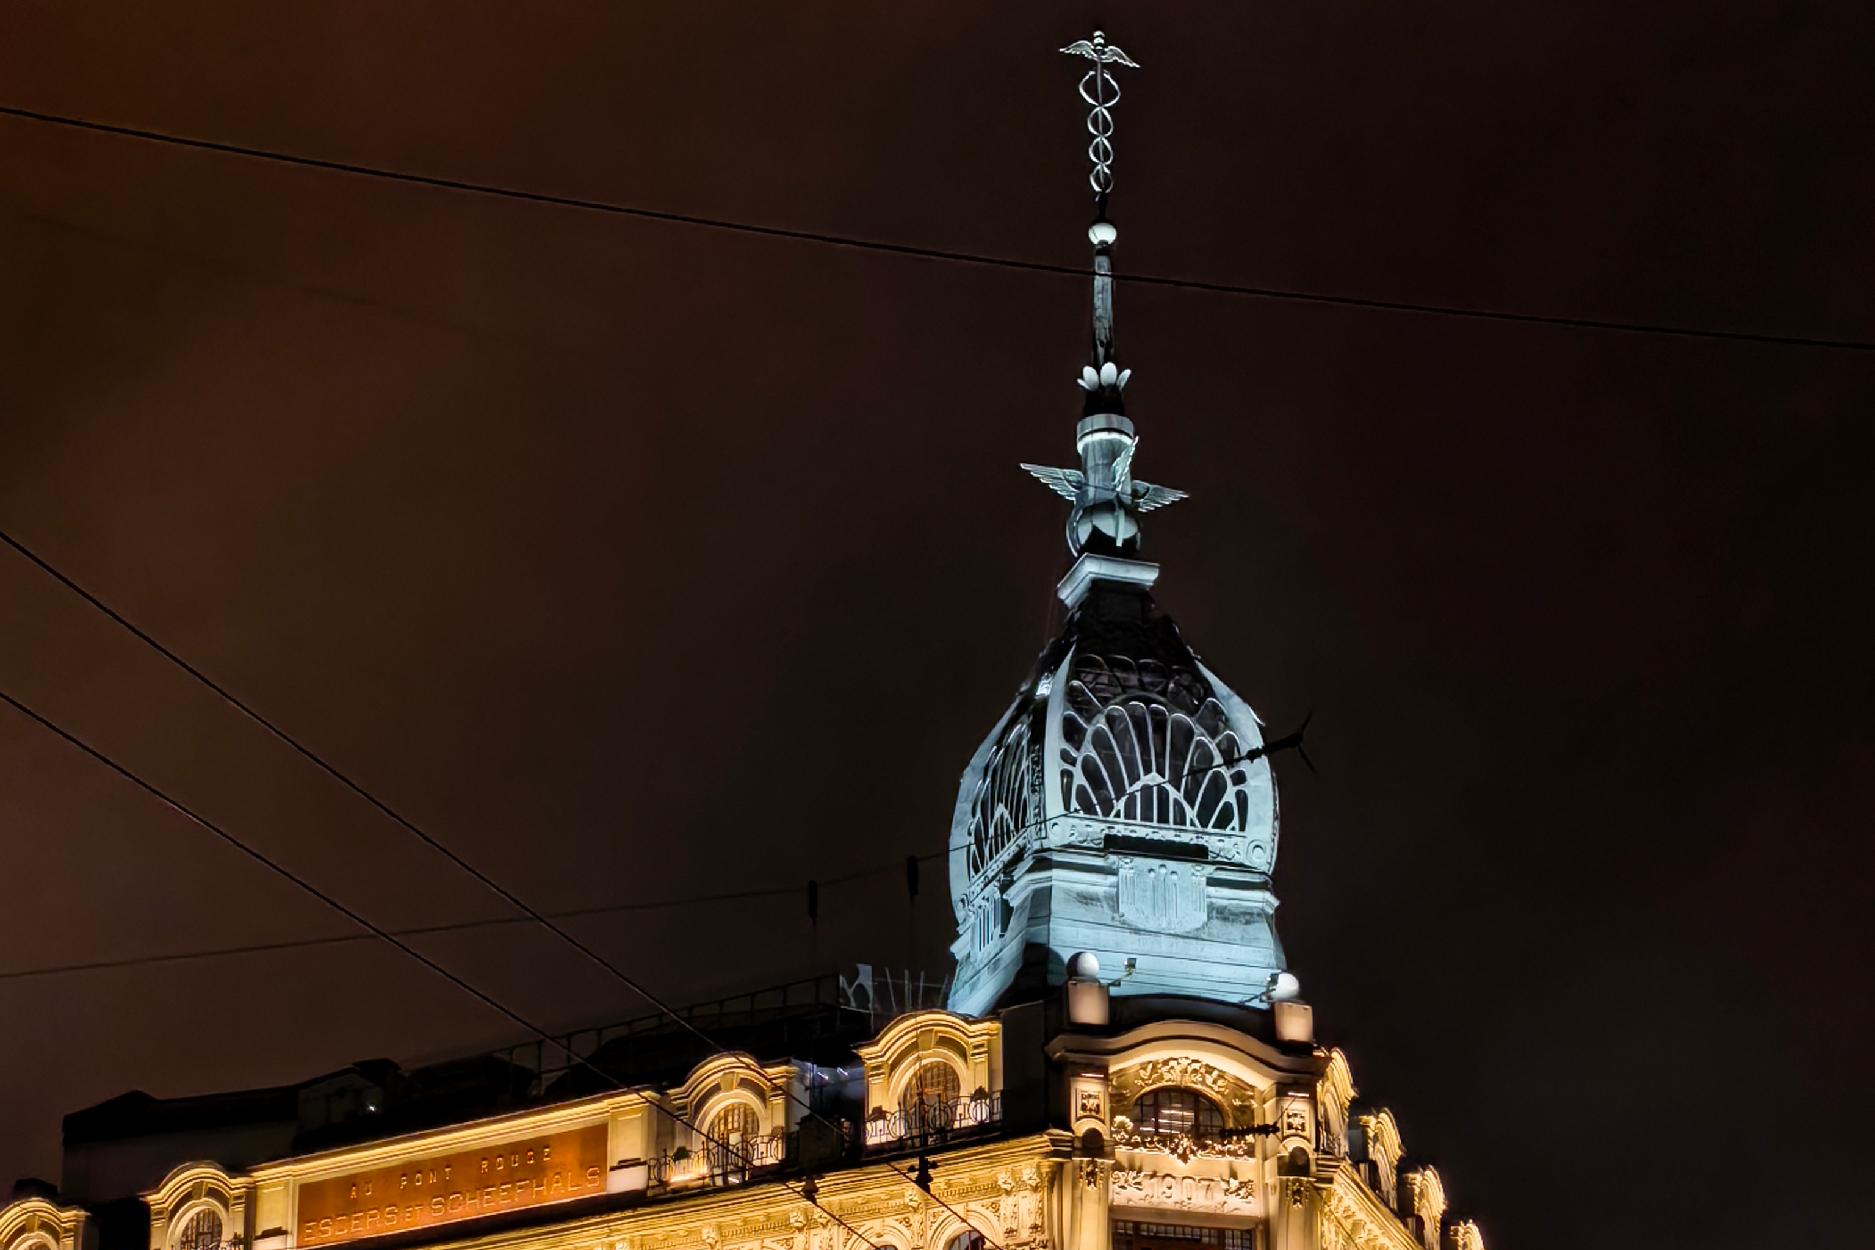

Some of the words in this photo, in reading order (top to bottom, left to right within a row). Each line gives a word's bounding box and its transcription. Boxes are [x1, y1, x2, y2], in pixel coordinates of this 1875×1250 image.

[350, 1182, 373, 1199] AU
[399, 1166, 452, 1189] PONT
[480, 1147, 551, 1174] ROUGE
[1149, 1173, 1217, 1203] 1907
